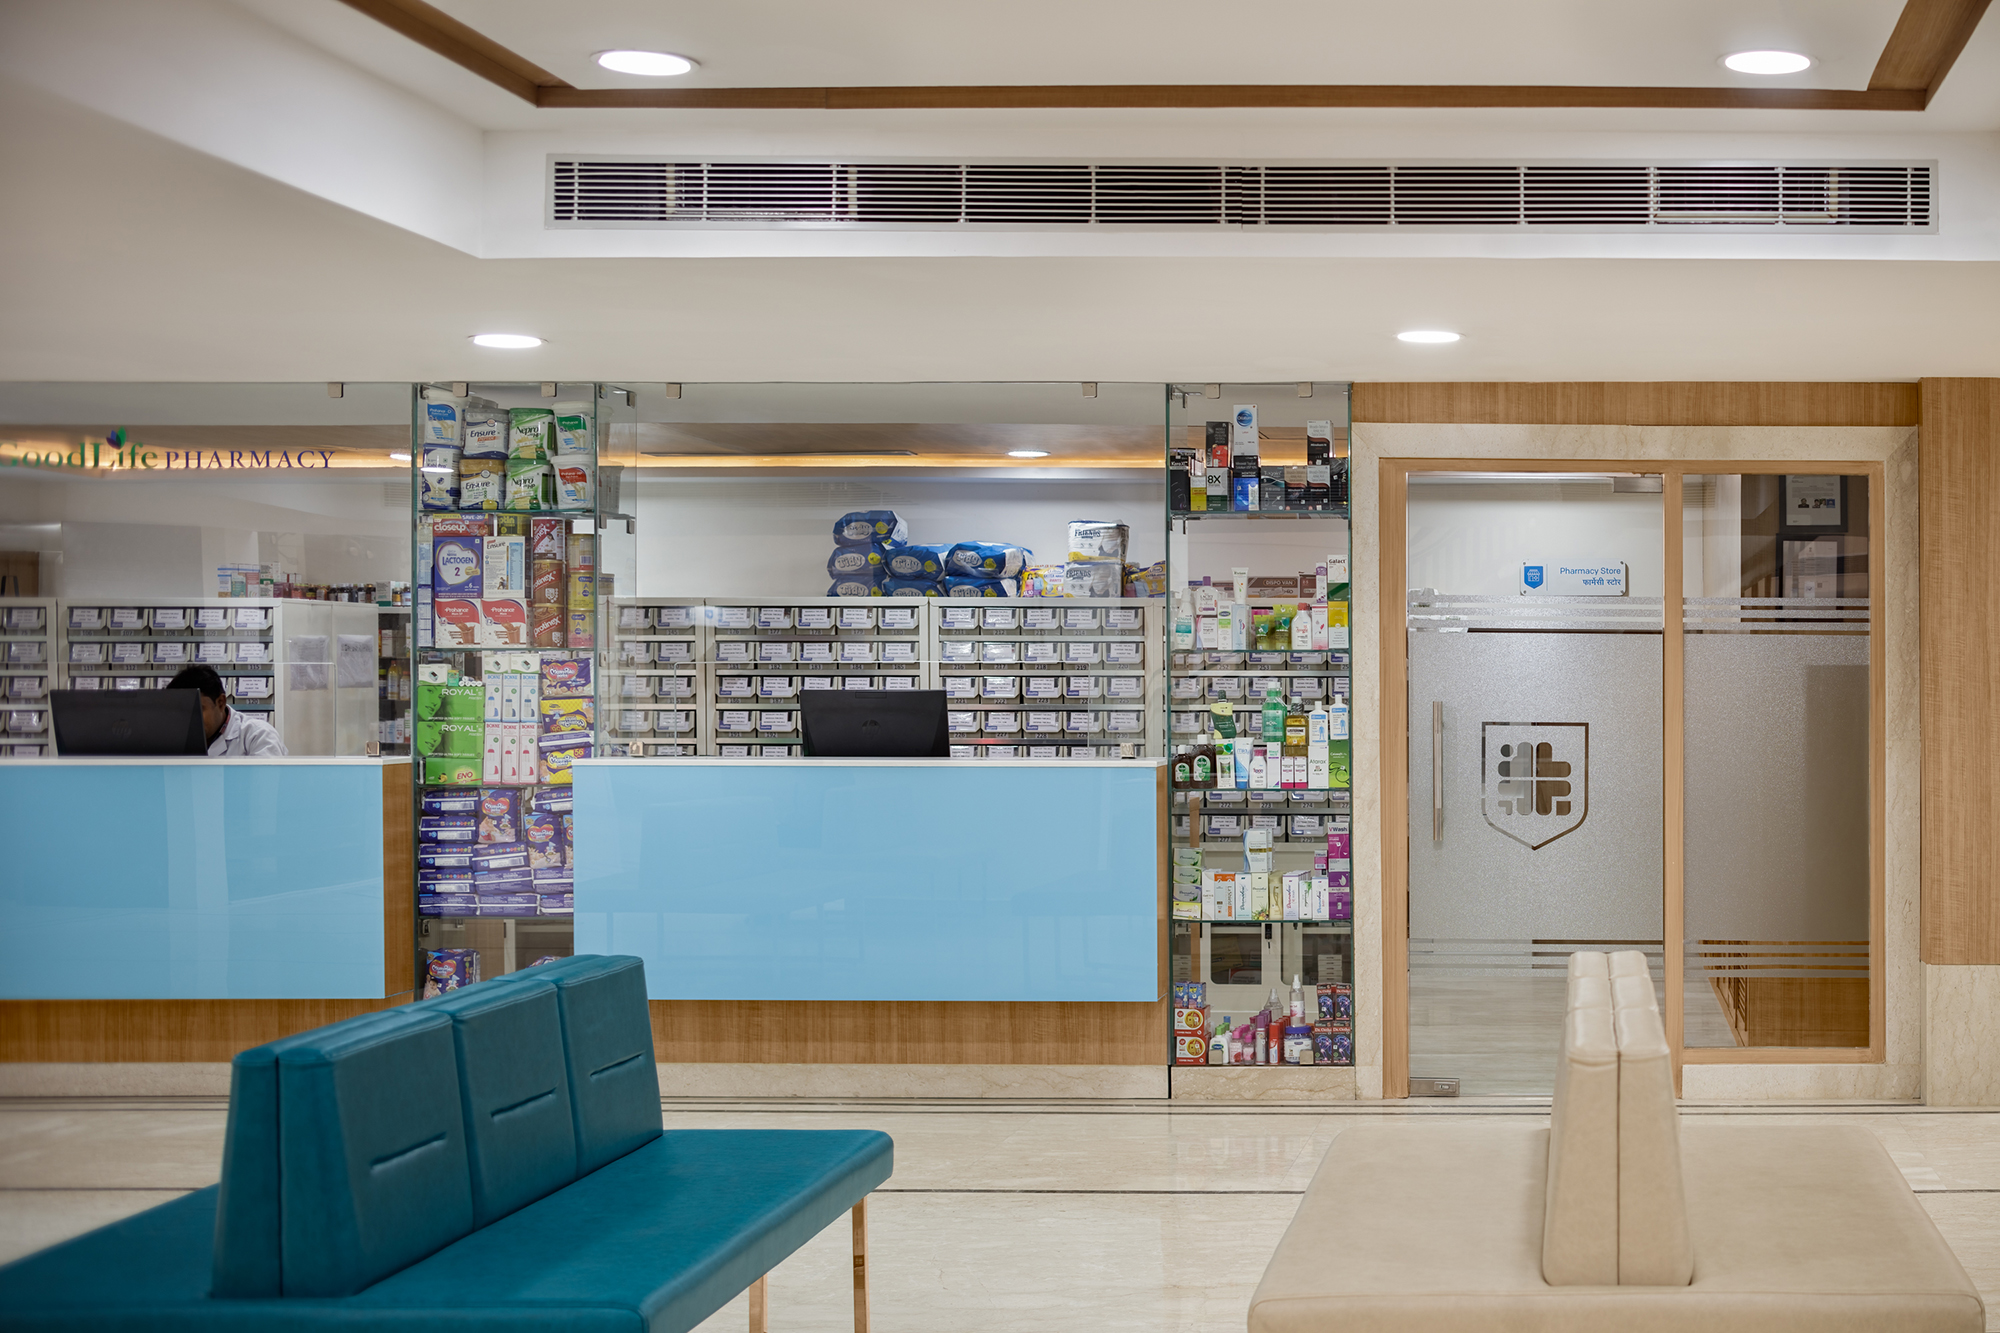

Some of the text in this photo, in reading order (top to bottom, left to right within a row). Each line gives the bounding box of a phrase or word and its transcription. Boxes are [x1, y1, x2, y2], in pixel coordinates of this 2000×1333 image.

[516, 426, 539, 435] Nepro
[165, 450, 336, 470] PHARMACY
[511, 478, 534, 486] Nepro
[1208, 475, 1221, 484] 8X
[434, 524, 466, 533] closeup
[442, 557, 473, 565] LACTOGEN
[837, 554, 863, 568] Tidy
[956, 551, 982, 567] Tidy
[895, 558, 919, 571] Tidy
[454, 567, 460, 576] 2
[1560, 567, 1599, 576] Pharmacy
[1606, 577, 1622, 586] स्टोर
[840, 585, 866, 597] Tidy
[952, 586, 978, 597] Tidy
[457, 772, 473, 780] ENO
